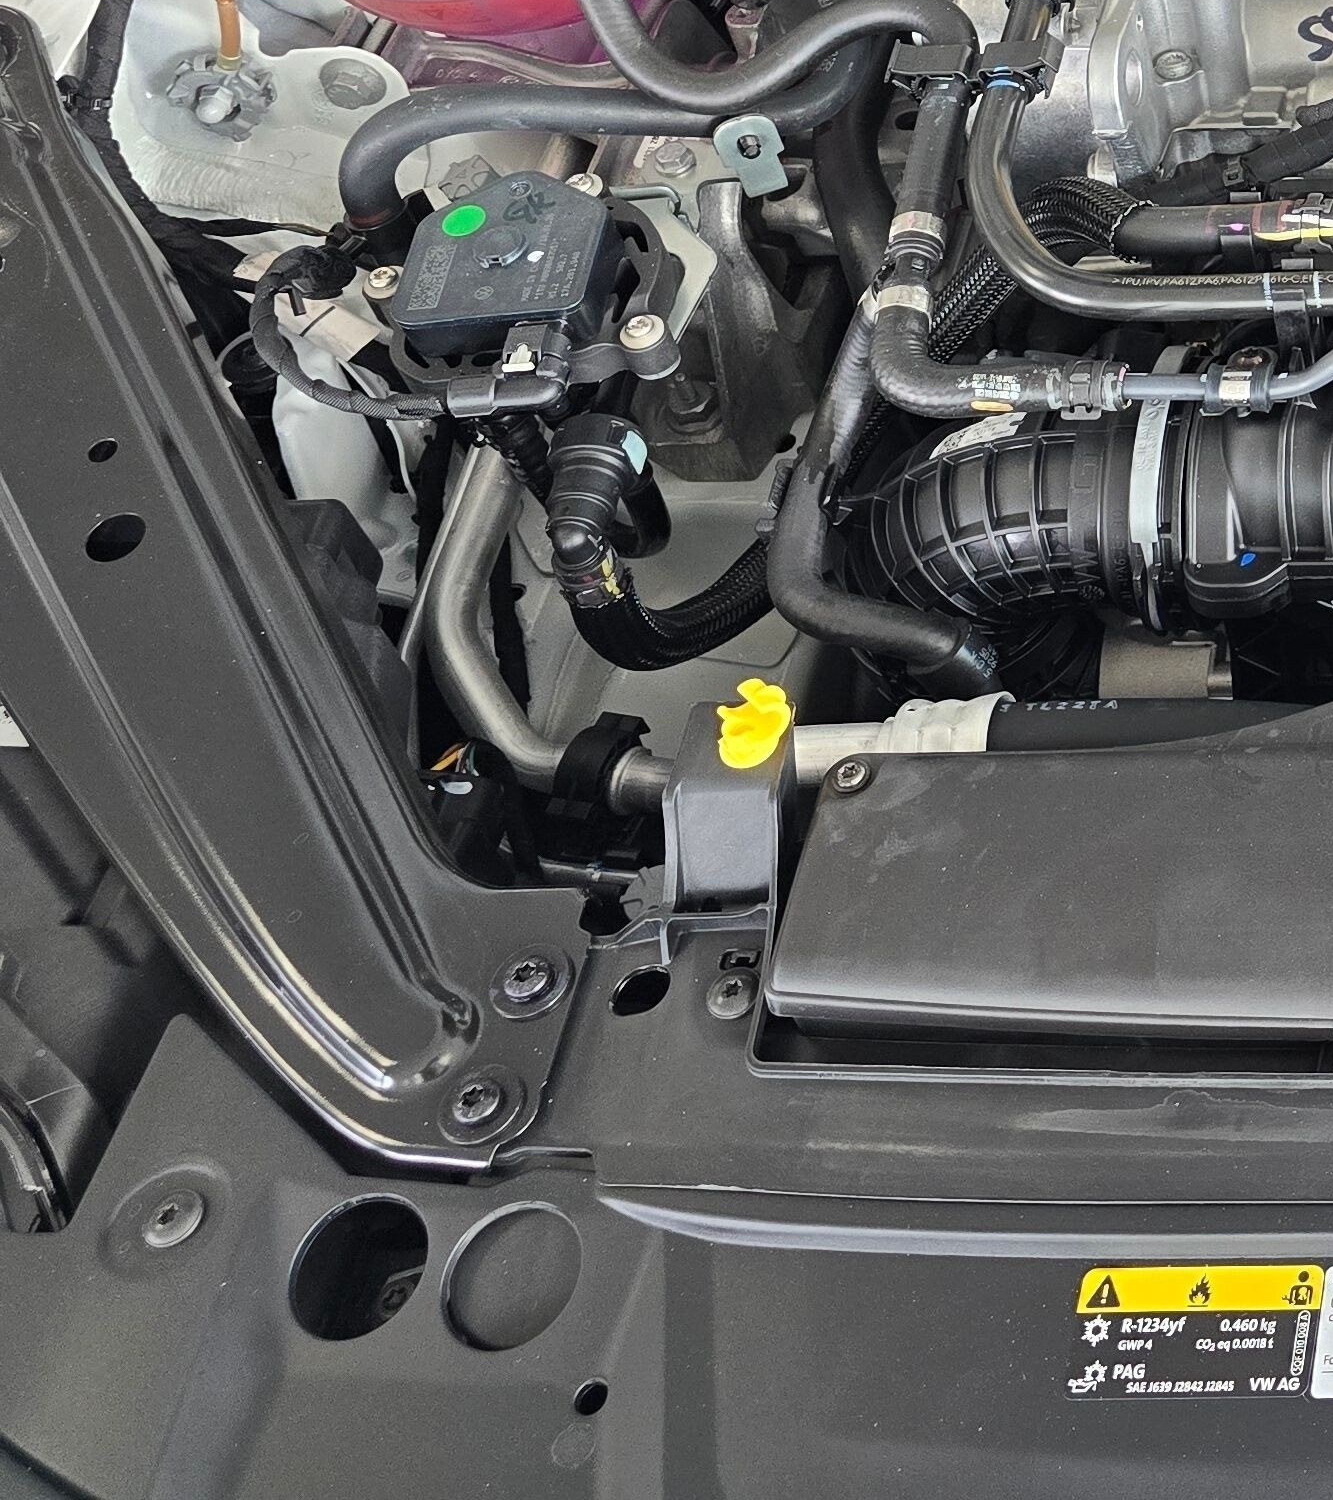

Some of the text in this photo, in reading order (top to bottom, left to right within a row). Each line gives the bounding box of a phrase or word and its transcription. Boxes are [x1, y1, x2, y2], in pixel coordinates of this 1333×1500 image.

[1121, 1316, 1187, 1337] R-1234yf
[1220, 1317, 1277, 1335] 0.460 kg
[1298, 1322, 1308, 1338] 008
[1117, 1339, 1153, 1351] GWP 4
[1216, 1337, 1274, 1352] eq 0.0018 t
[1295, 1339, 1305, 1354] 010
[1112, 1363, 1146, 1380] PAG
[1125, 1380, 1235, 1393] SAE J639 J2842 J2845
[1249, 1376, 1301, 1392] VW AG
